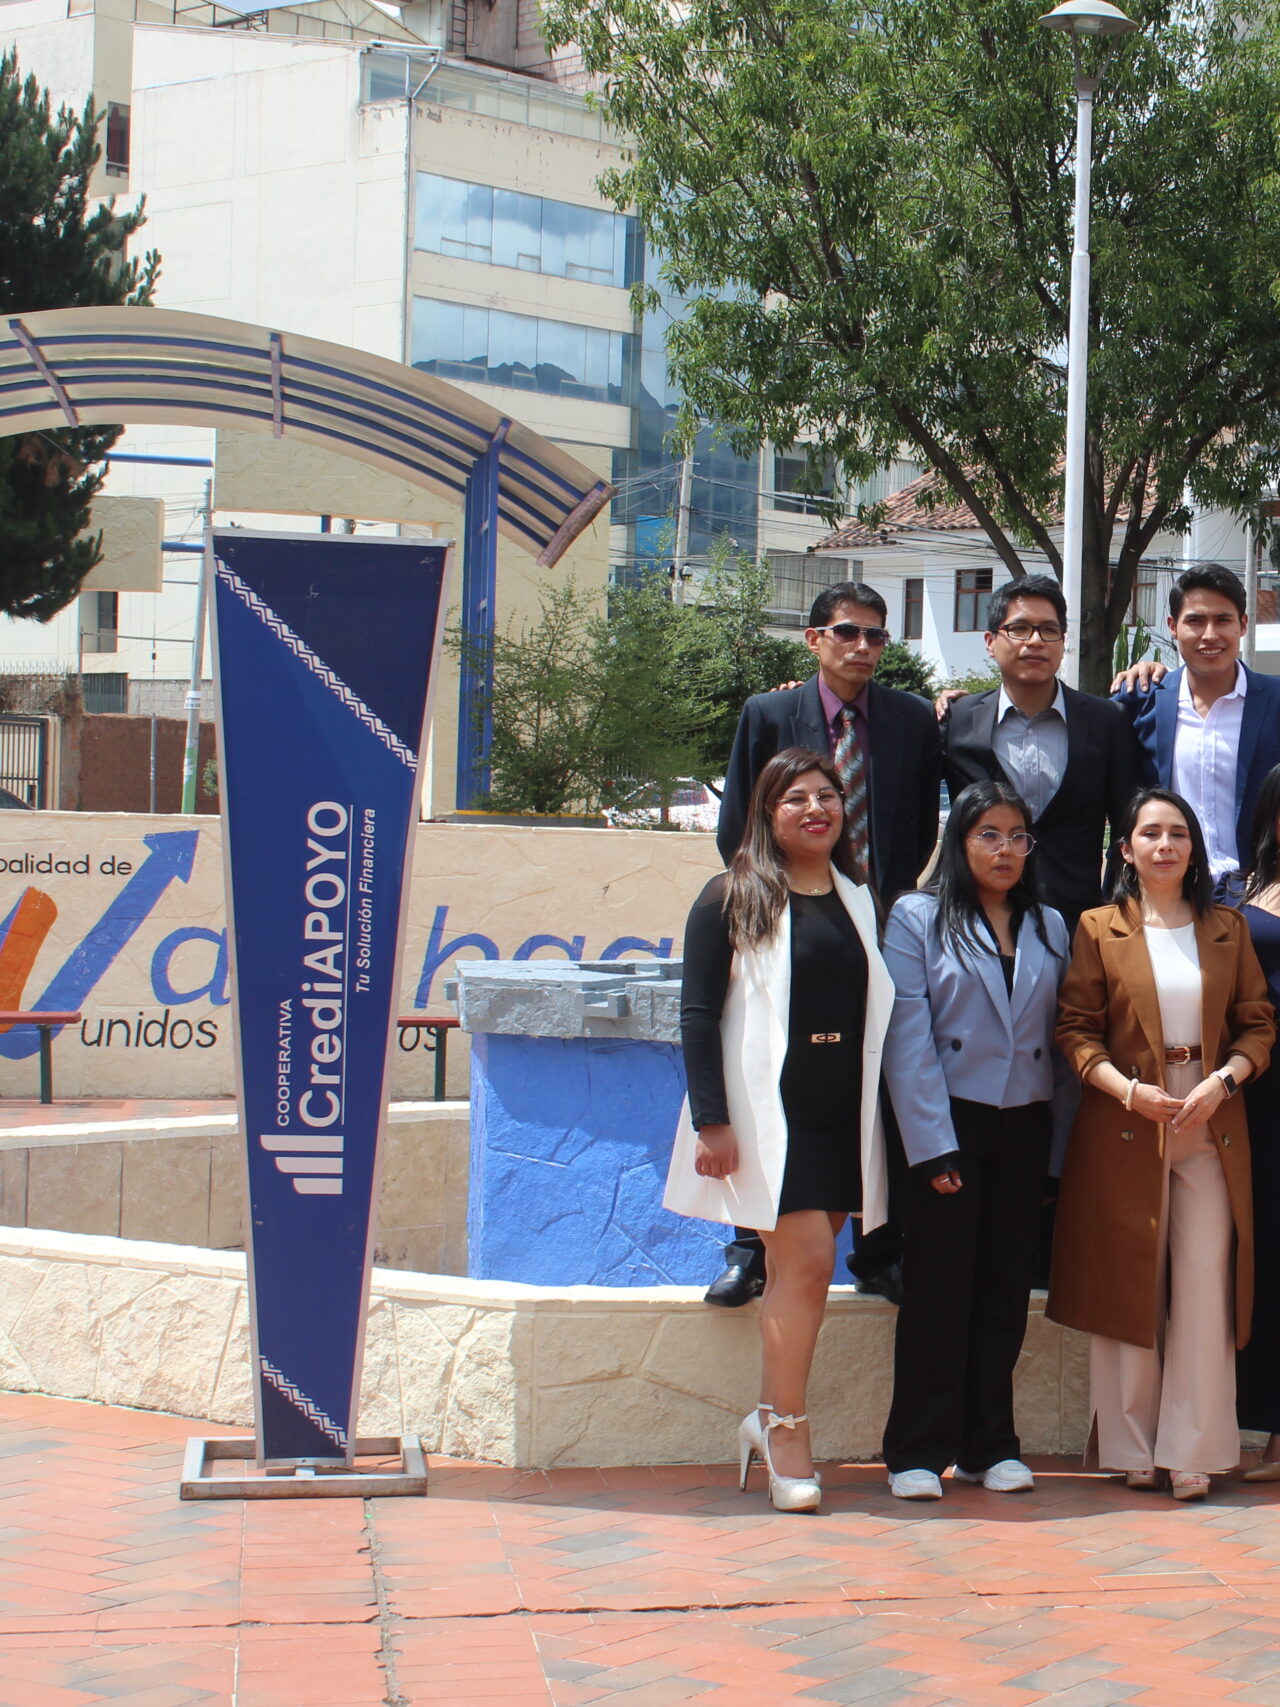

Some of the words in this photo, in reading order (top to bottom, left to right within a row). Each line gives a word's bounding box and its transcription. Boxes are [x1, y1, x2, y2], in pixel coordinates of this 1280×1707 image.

[100, 855, 133, 875] de
[359, 808, 376, 894] Financiera
[299, 800, 348, 1128] CrediAPOYO
[357, 898, 373, 969] Solución
[356, 973, 370, 993] Tu
[81, 1008, 218, 1049] unidos
[277, 998, 293, 1127] COOPERATIVA
